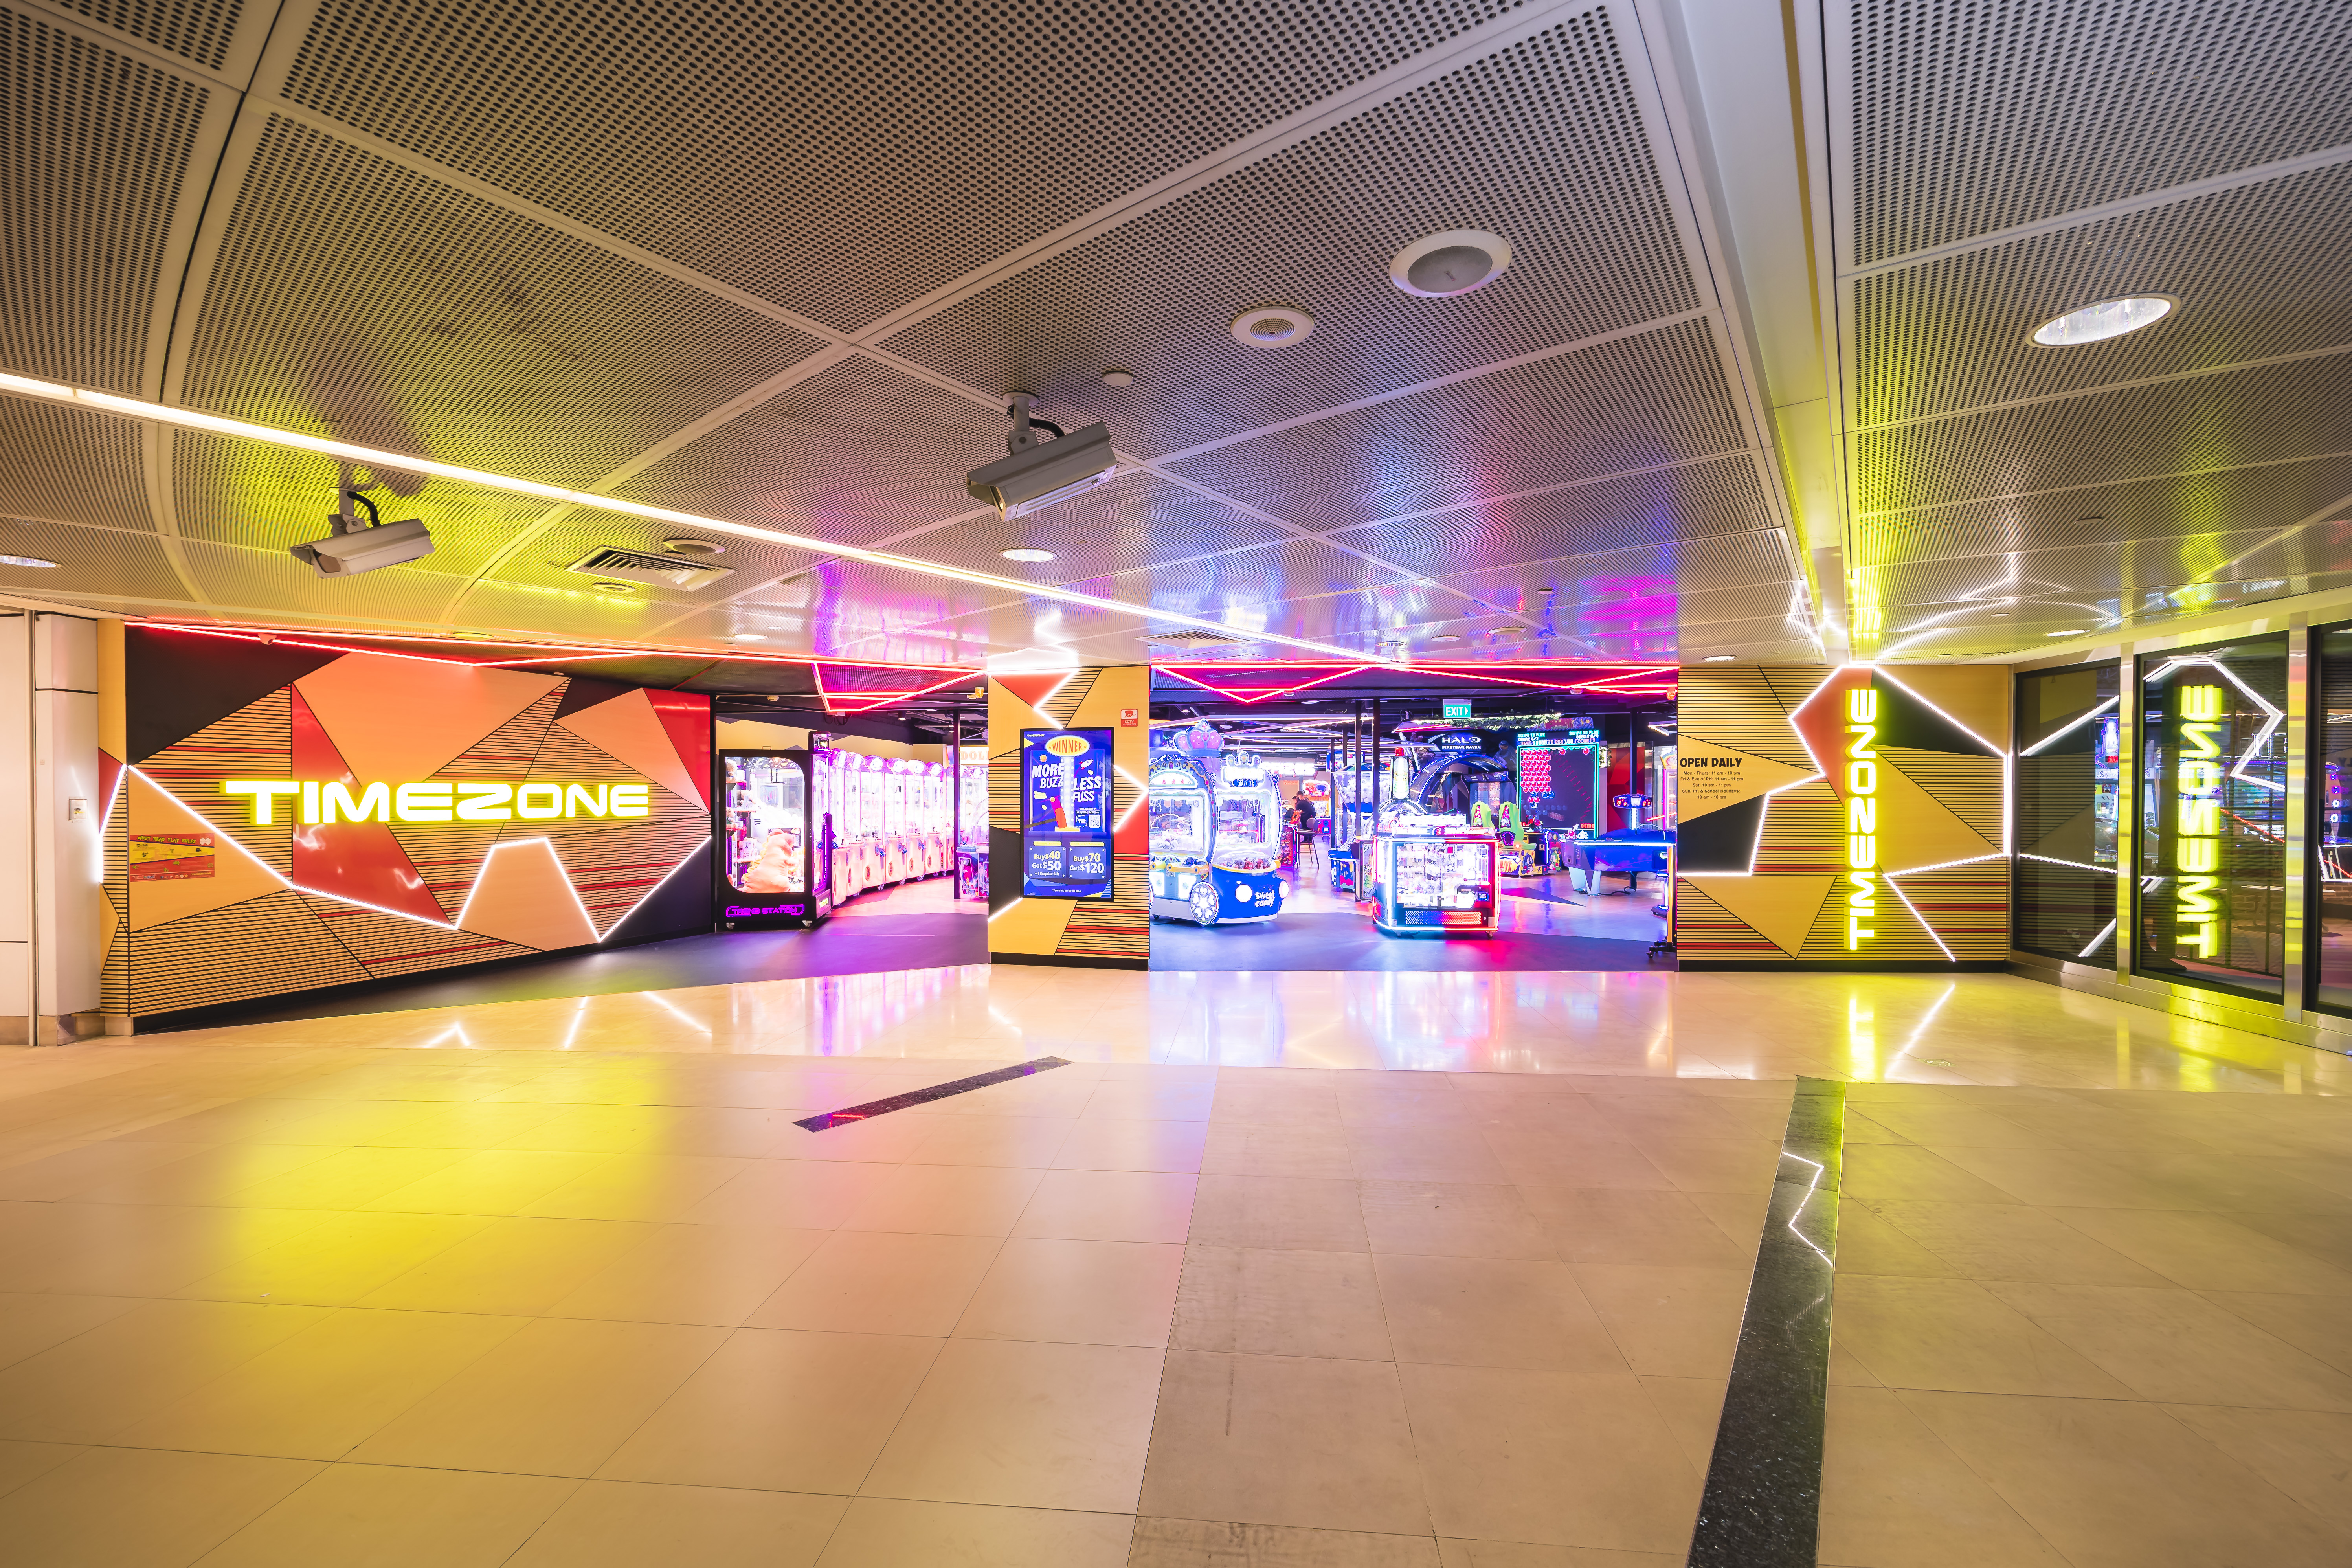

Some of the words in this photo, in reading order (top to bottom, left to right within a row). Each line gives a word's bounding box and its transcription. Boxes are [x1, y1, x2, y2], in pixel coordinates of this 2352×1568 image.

[1445, 707, 1463, 716] EXIT
[1052, 739, 1082, 753] WINNER
[1680, 757, 1708, 767] OPEN
[1711, 757, 1742, 767] DAILY
[1032, 763, 1065, 778] MORE
[1040, 776, 1064, 789] BUZZ
[1073, 776, 1102, 791] LESS
[221, 780, 649, 825] TIMEZONE
[1072, 790, 1094, 802] FUSS
[1846, 689, 1876, 950] TIMEZONE
[1255, 889, 1275, 900] sweet
[1255, 898, 1274, 907] candy
